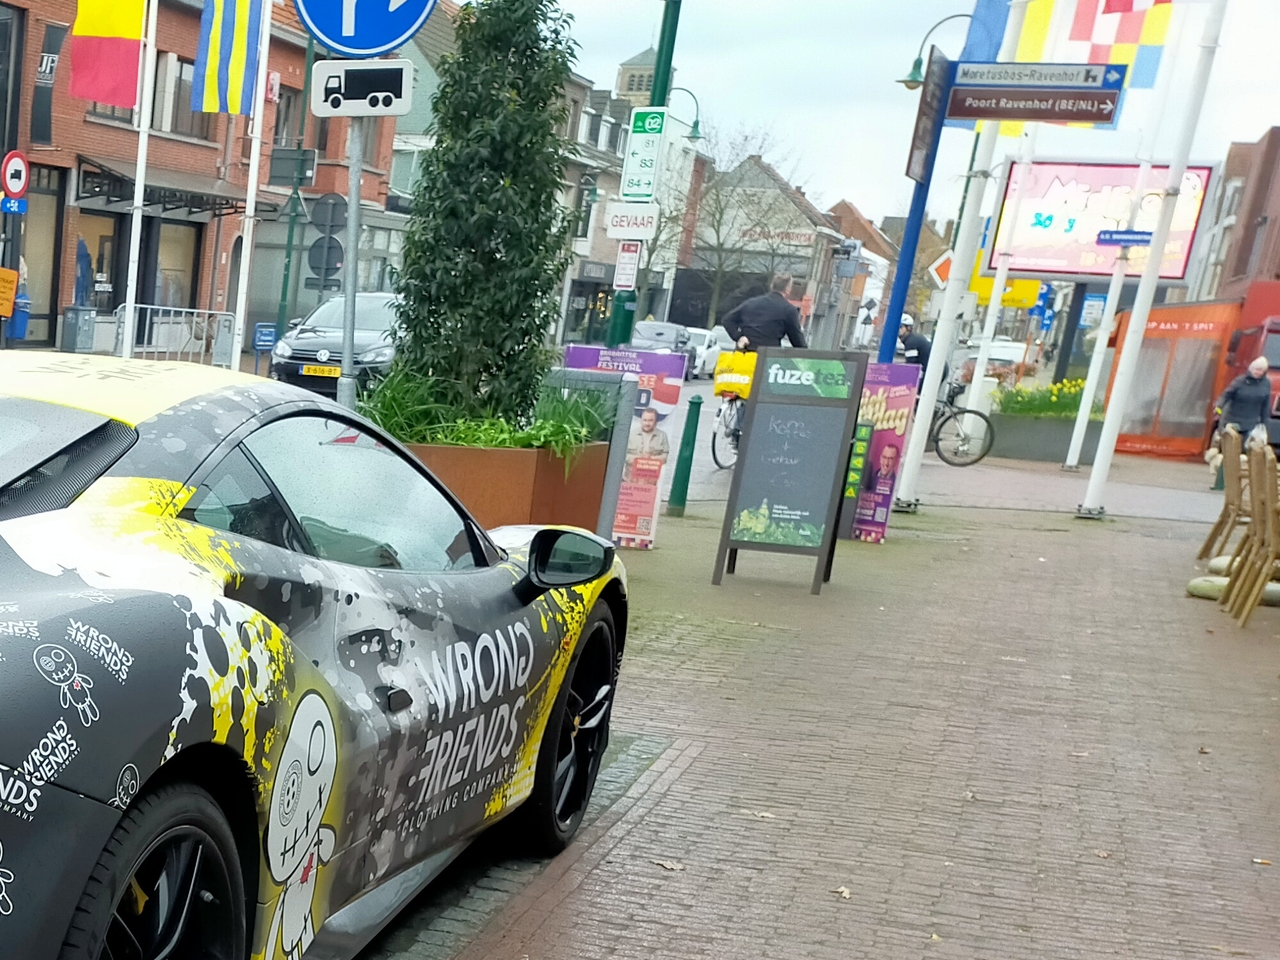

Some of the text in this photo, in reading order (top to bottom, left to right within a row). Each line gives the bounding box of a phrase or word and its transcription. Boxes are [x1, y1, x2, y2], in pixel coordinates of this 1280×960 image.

[960, 68, 1081, 82] Moretusbos-Ravenhof
[965, 97, 997, 108] Poort
[999, 98, 1053, 110] Ravenhof
[610, 215, 654, 229] GEVAAR
[597, 361, 642, 372] FESTIVAL
[768, 364, 815, 385] fuze
[67, 626, 129, 680] FRIENDS
[69, 618, 133, 668] WRONG
[416, 622, 535, 723] WRONG
[416, 696, 528, 811] FRIENDS
